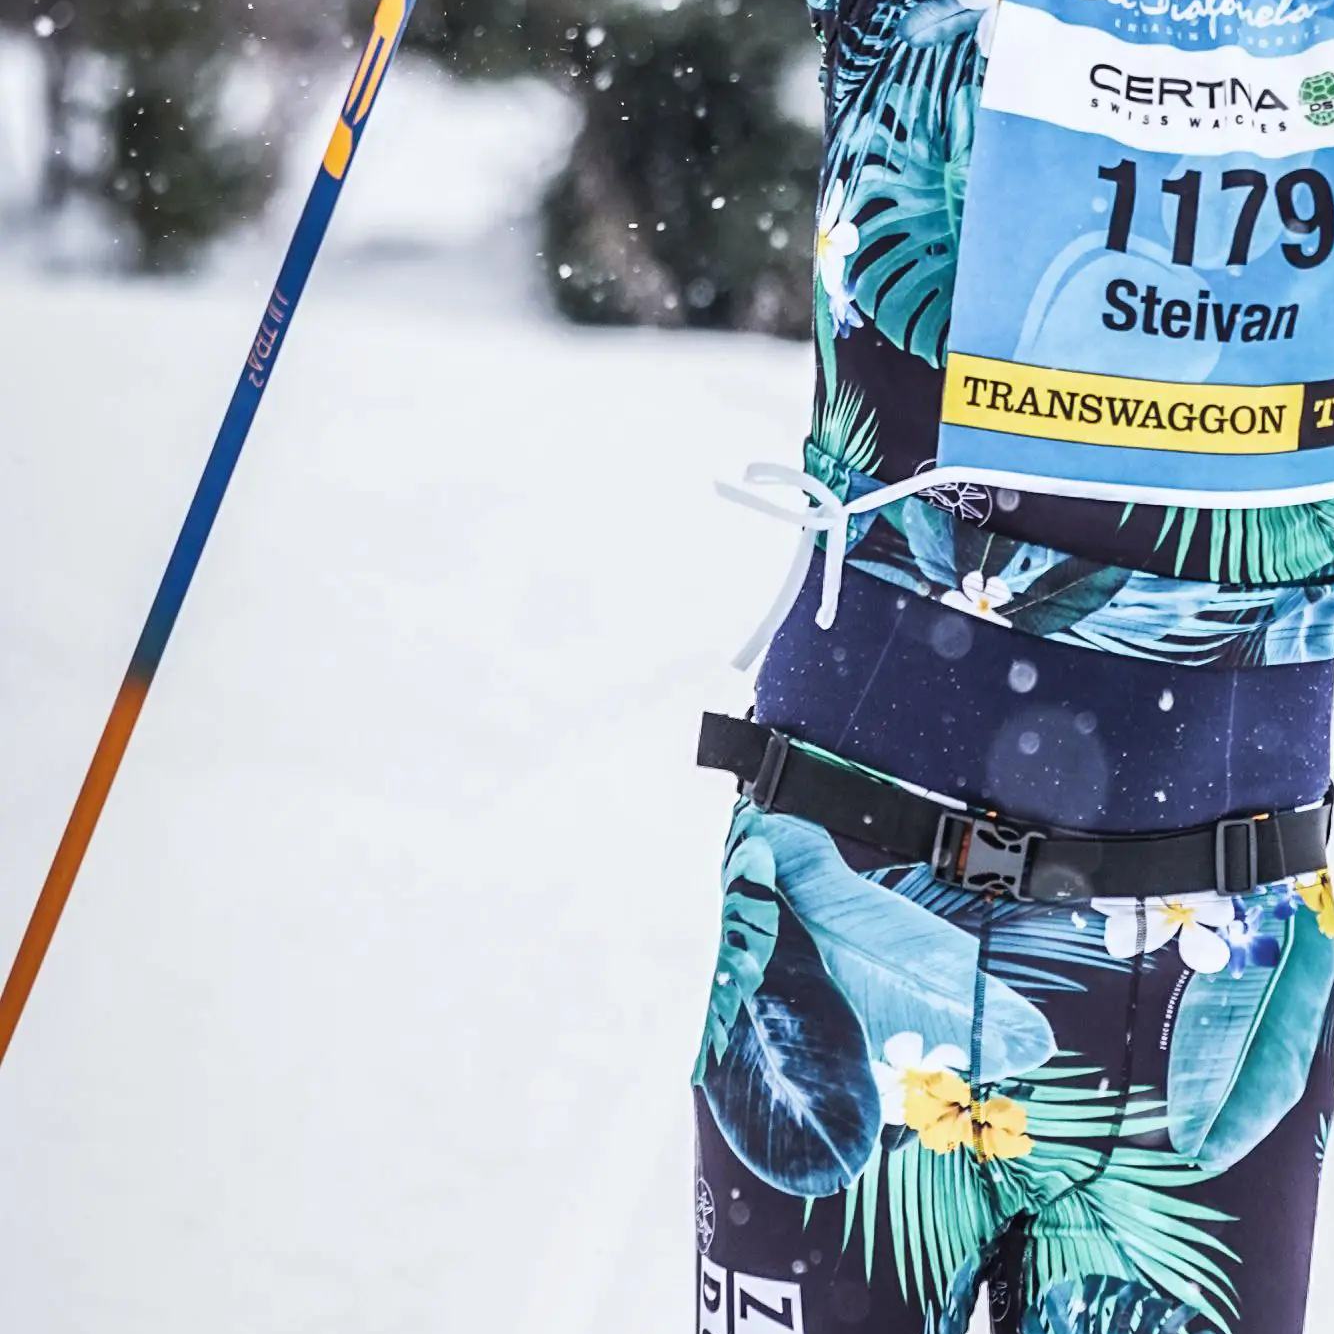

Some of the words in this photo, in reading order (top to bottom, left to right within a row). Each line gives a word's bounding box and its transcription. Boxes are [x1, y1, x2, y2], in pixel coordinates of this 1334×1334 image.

[1091, 98, 1169, 126] SWISS
[1102, 278, 1300, 344] Steivan
[962, 376, 1288, 435] TRANSWAGGON
